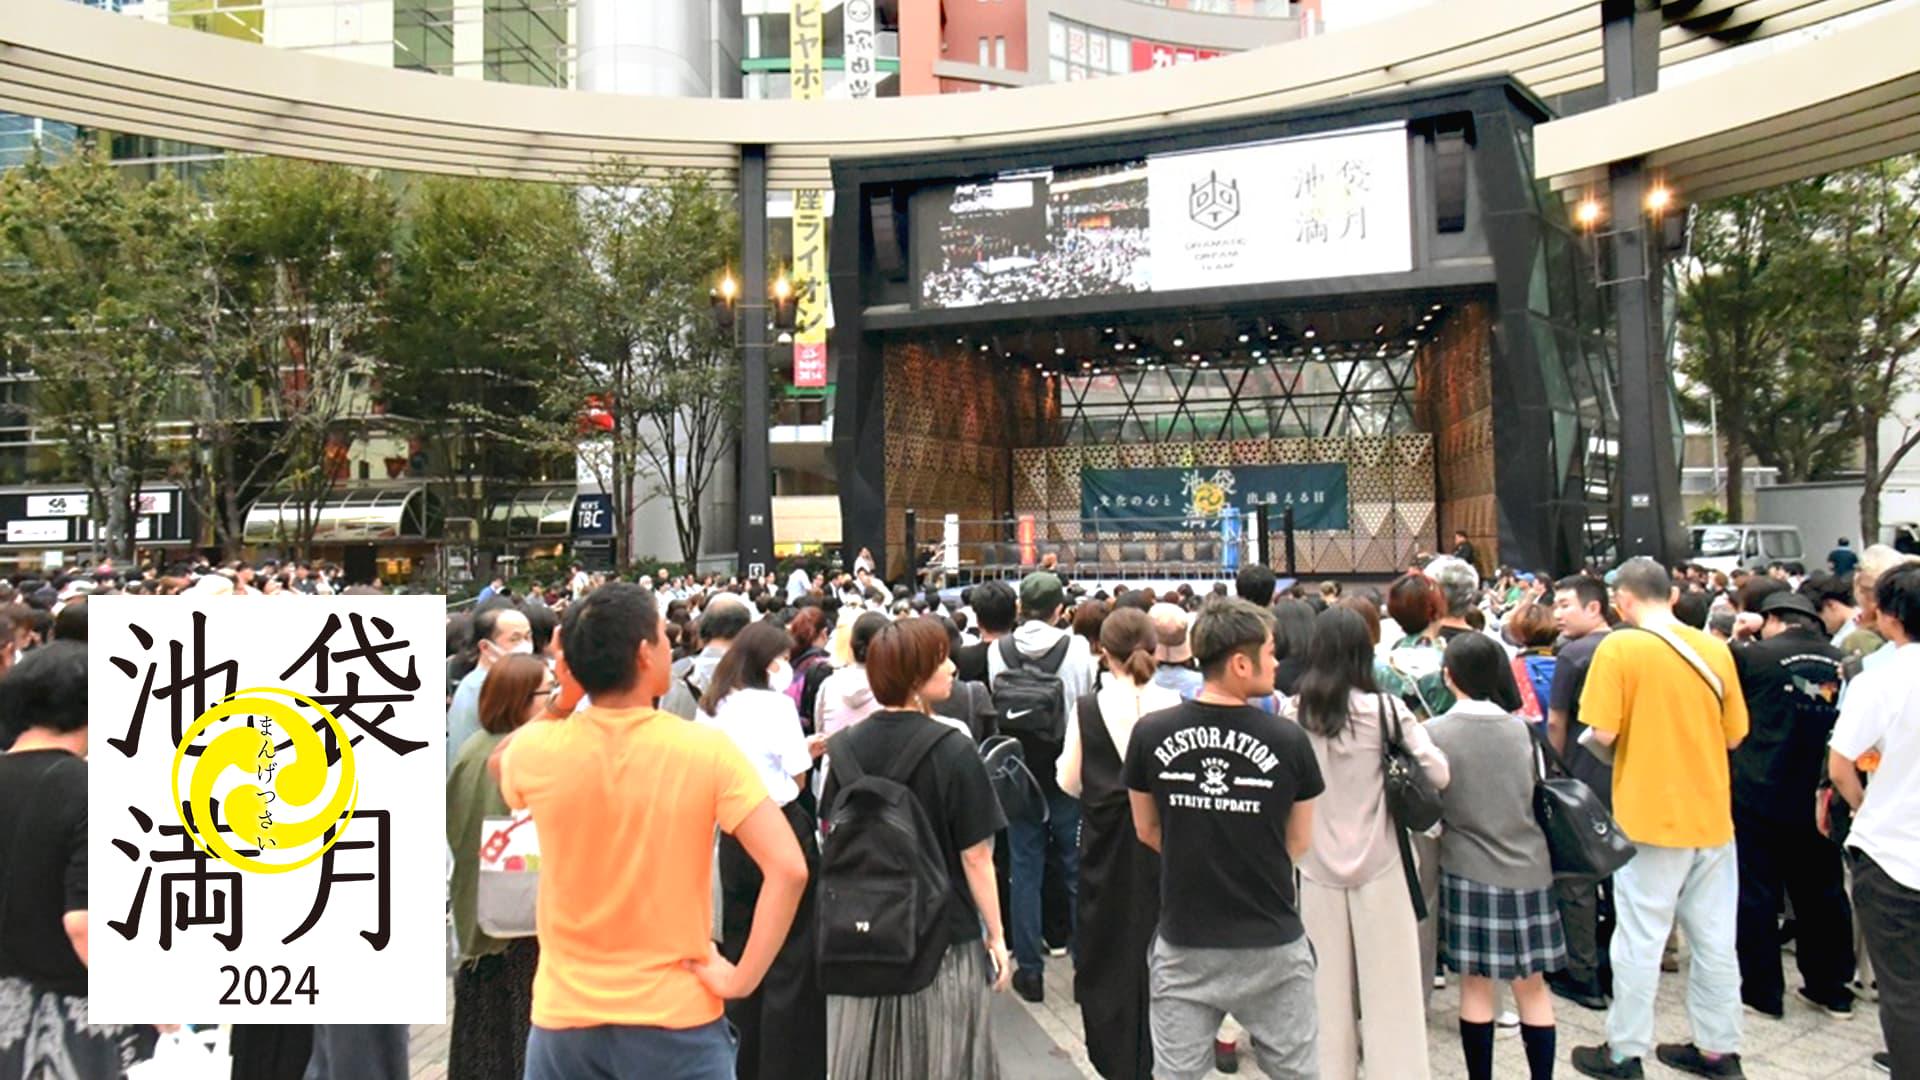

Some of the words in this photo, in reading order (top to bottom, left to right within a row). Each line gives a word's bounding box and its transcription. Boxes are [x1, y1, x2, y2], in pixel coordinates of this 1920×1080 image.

[578, 510, 604, 528] TBC
[1154, 726, 1280, 774] RESTORATION
[1169, 794, 1211, 810] STRIVE
[1215, 798, 1260, 814] UPDATE
